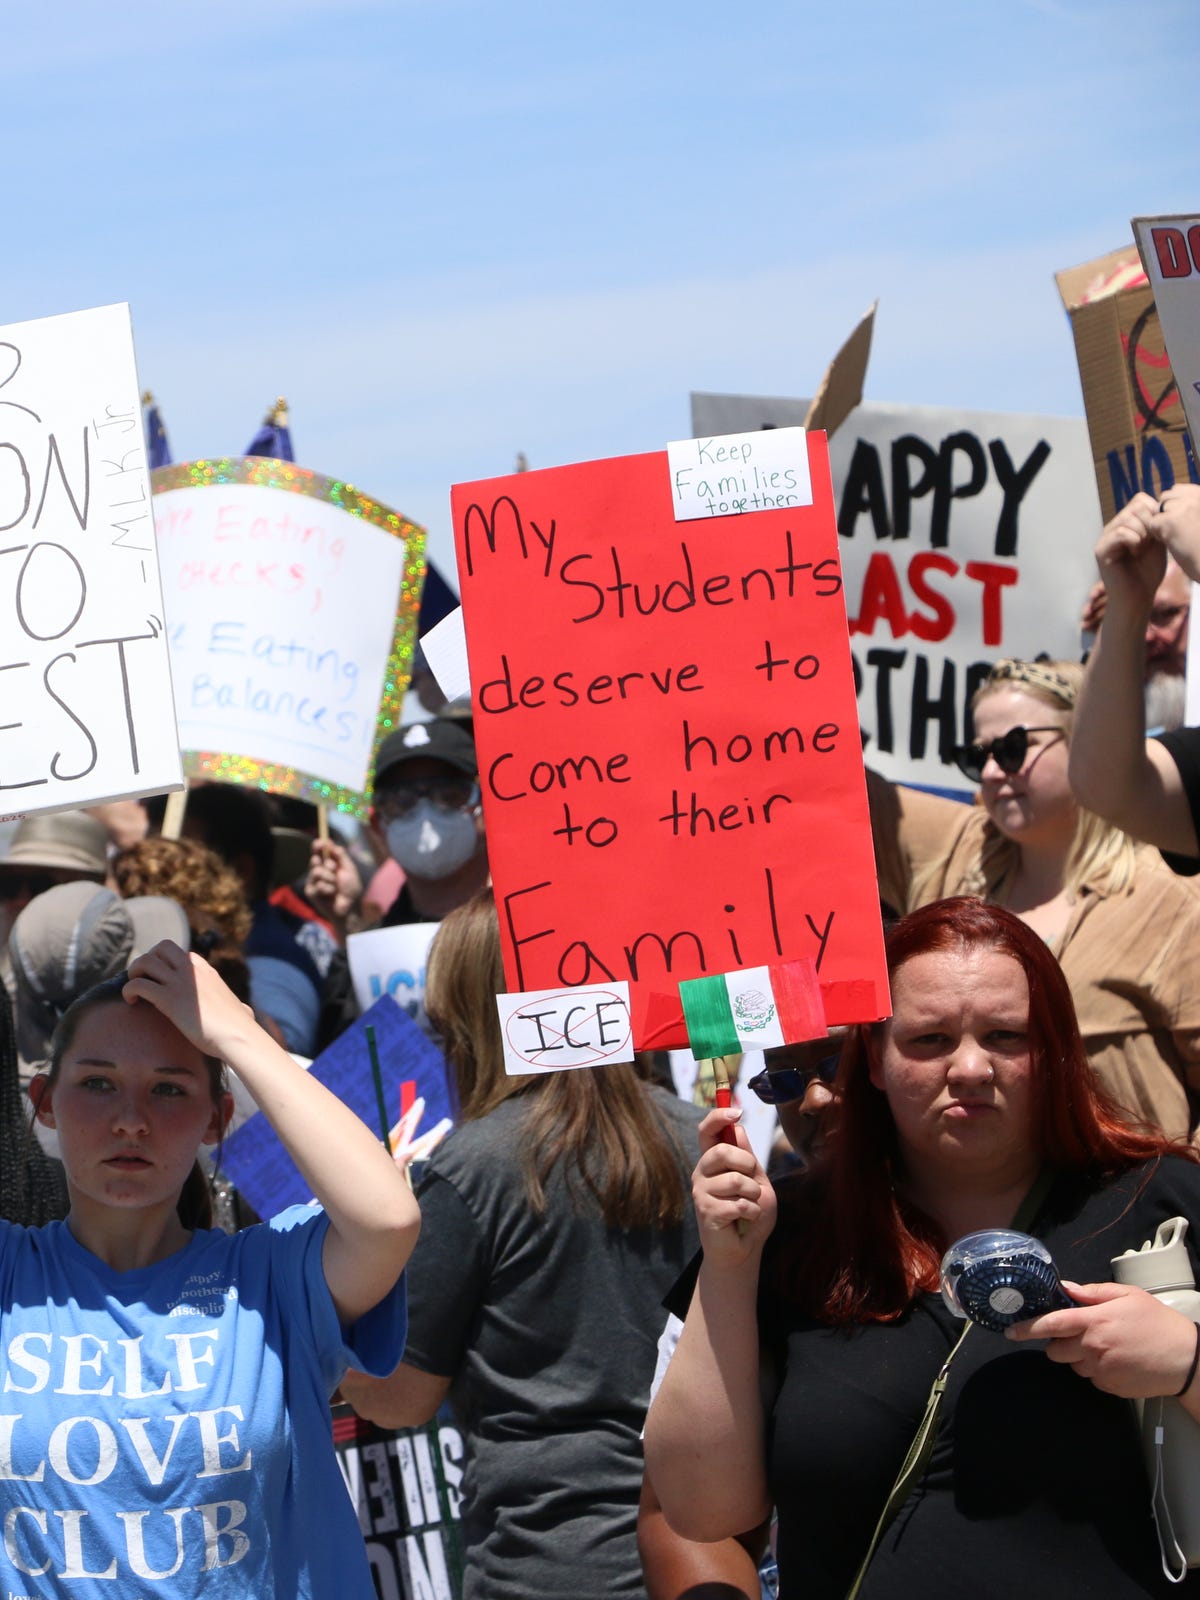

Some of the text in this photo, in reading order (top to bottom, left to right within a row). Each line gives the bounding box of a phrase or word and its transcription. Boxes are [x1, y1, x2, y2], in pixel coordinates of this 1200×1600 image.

[674, 466, 799, 501] Families
[696, 438, 753, 466] Keep
[705, 491, 799, 515] together
[836, 429, 1054, 557] APPY
[464, 494, 843, 624] My Students
[847, 550, 1019, 648] AST
[206, 621, 361, 702] Eating
[477, 640, 821, 715] deserve to
[681, 720, 841, 772] home
[552, 788, 793, 849] to their
[501, 866, 836, 994] Family
[516, 1000, 627, 1054] ICE
[2, 1326, 220, 1401] SELF
[3, 1498, 253, 1581] CLUB
